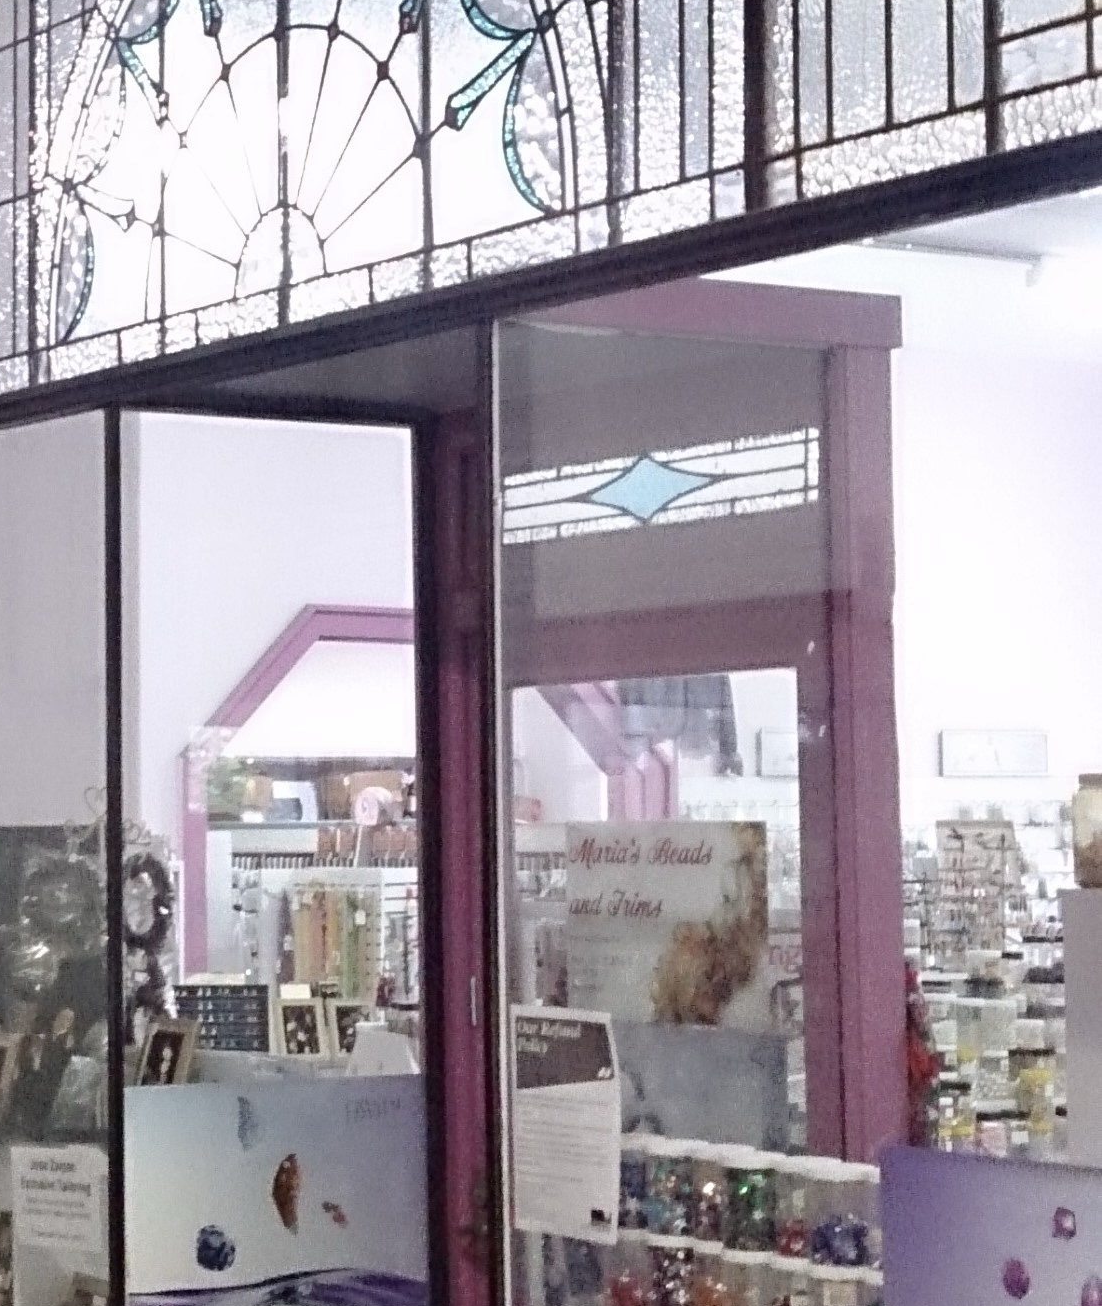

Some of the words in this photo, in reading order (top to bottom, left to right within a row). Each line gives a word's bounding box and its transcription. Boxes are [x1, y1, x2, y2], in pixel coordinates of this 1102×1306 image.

[570, 838, 641, 869] Maria's
[649, 838, 713, 866] Beads
[569, 893, 603, 915] and
[608, 888, 663, 918] Trims
